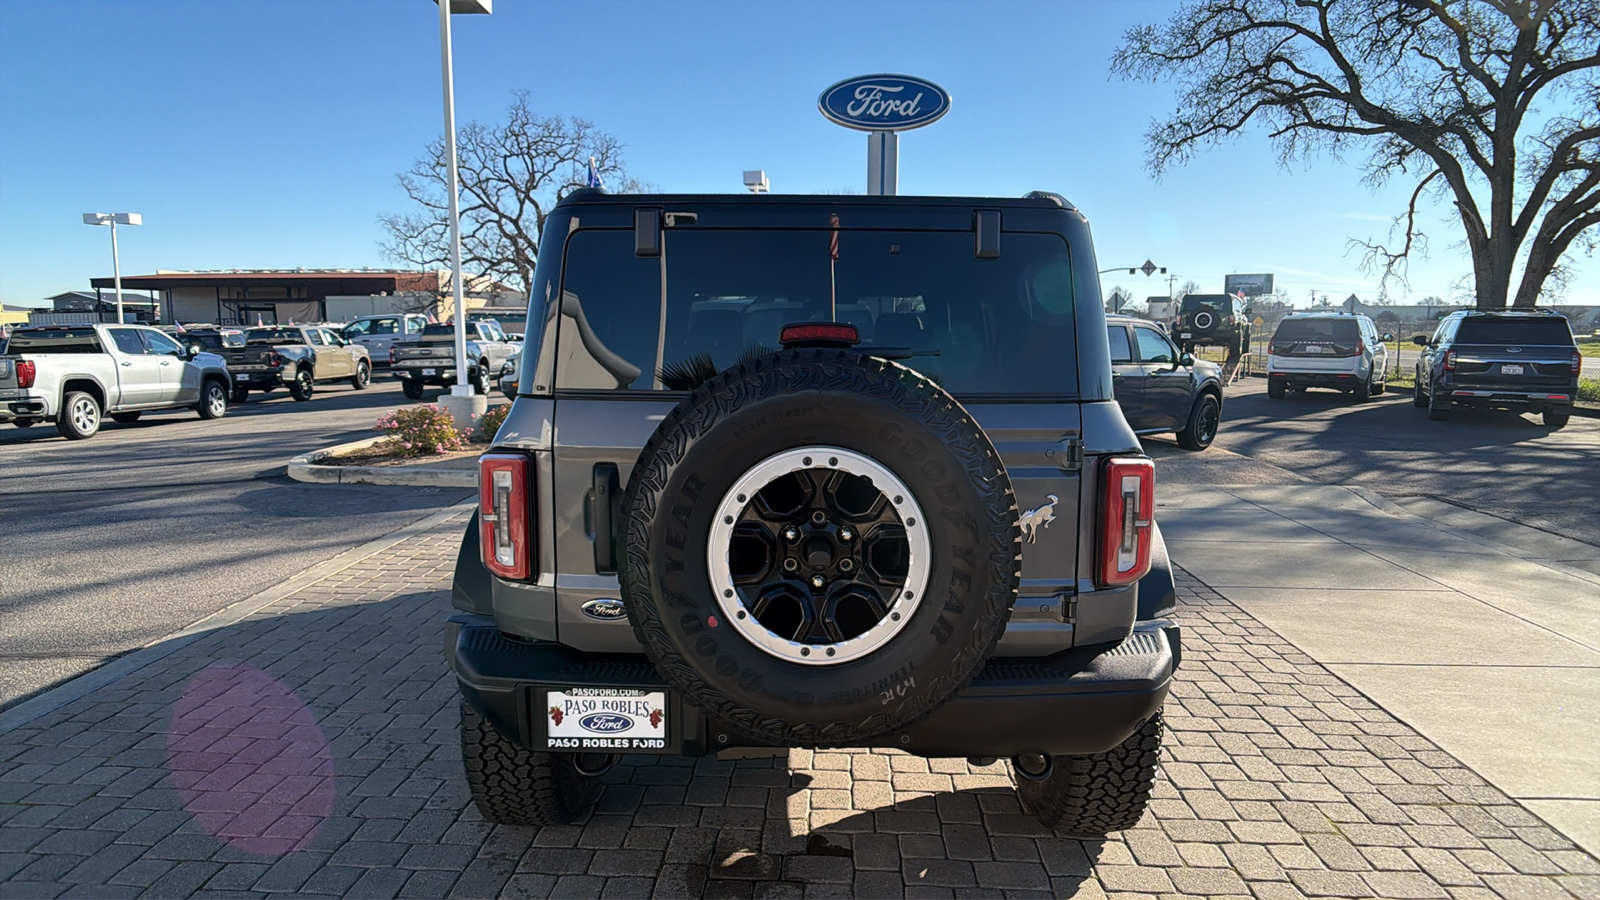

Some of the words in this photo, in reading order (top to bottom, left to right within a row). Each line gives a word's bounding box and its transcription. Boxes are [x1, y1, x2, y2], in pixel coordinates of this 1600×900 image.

[847, 84, 924, 117] Ford
[592, 603, 621, 616] Ford
[572, 688, 639, 697] PASOFORD.COM
[565, 699, 596, 716] PASO
[601, 700, 649, 718] ROBLES
[590, 716, 624, 730] Ford
[547, 739, 580, 748] PASO
[582, 739, 630, 748] ROBLES
[632, 739, 665, 749] FORD
